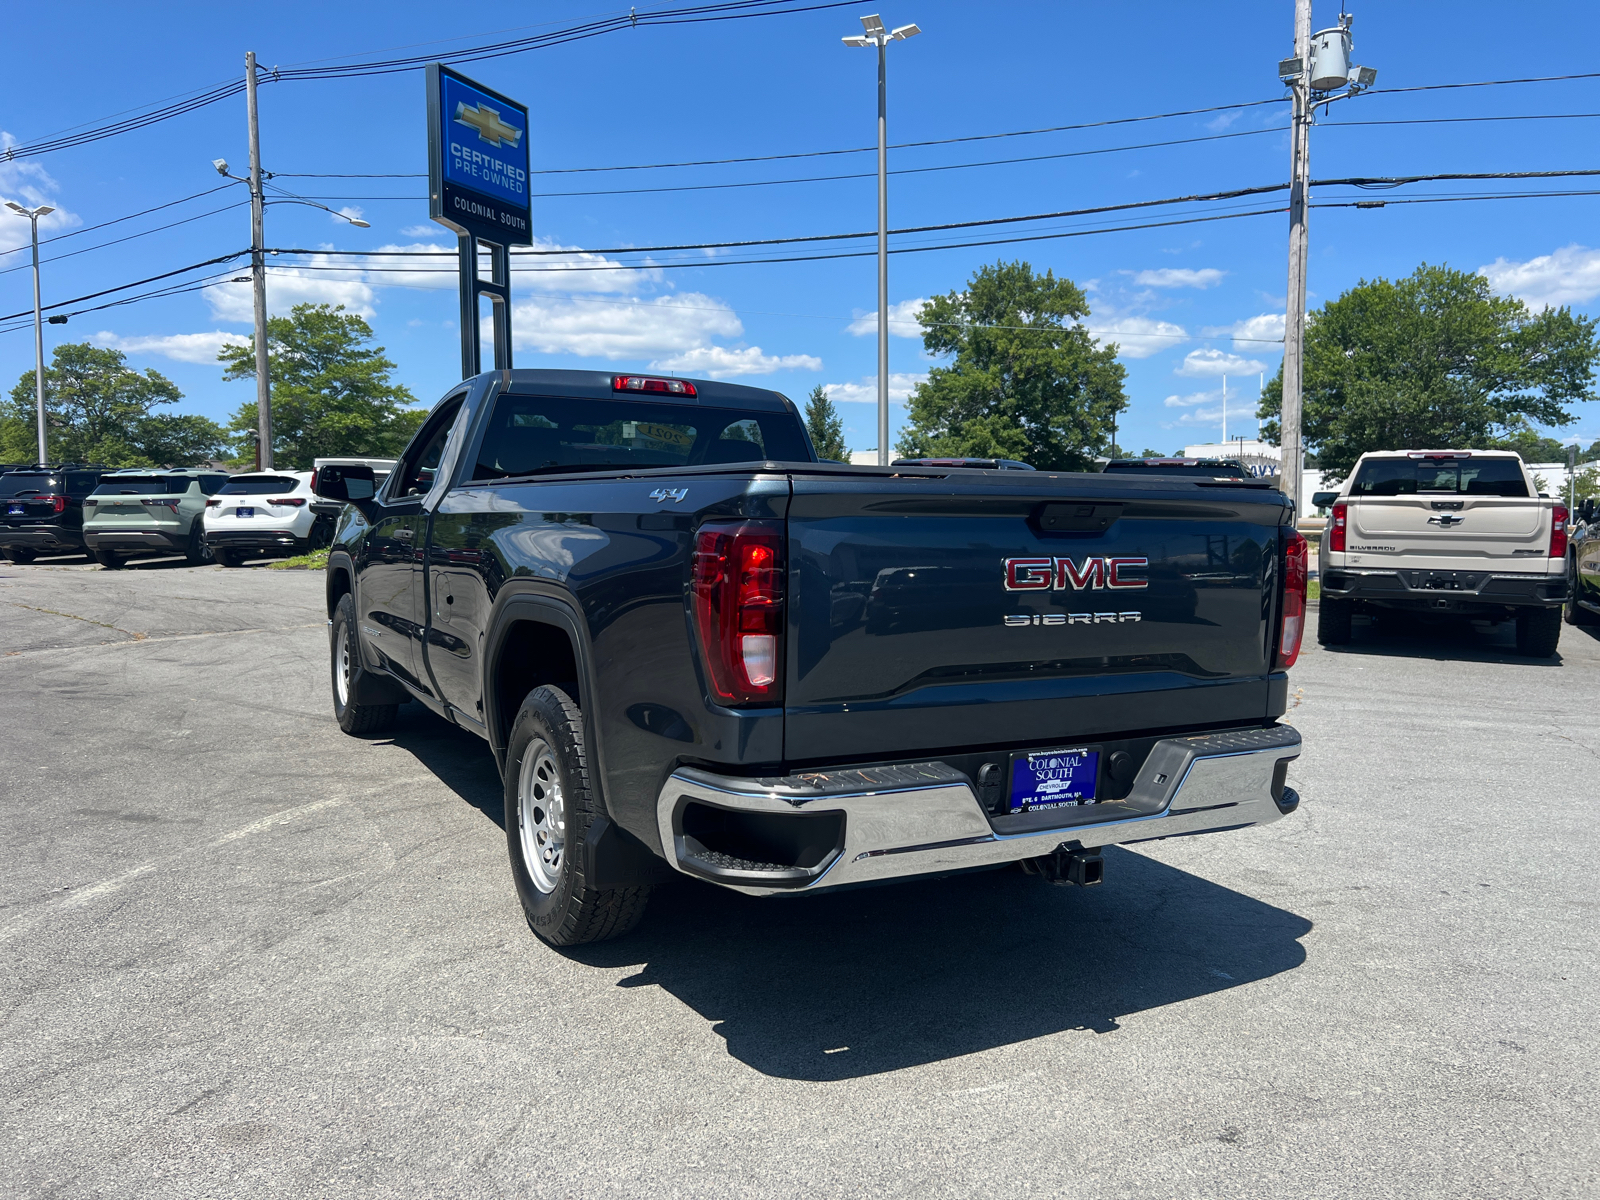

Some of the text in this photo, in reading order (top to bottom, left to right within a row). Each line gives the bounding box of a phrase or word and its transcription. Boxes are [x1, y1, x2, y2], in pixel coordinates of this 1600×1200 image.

[450, 142, 526, 182] CERTIFIED
[455, 158, 523, 194] PRE-OWNED
[454, 196, 526, 230] COLONIAL SOUTH
[1003, 556, 1149, 591] GMC
[1003, 611, 1142, 627] SIERRA
[1029, 756, 1082, 771] COLONIAL
[1036, 768, 1072, 780] SOUTH
[1039, 782, 1068, 790] CHEVROLET
[1028, 803, 1057, 811] COLONIAL
